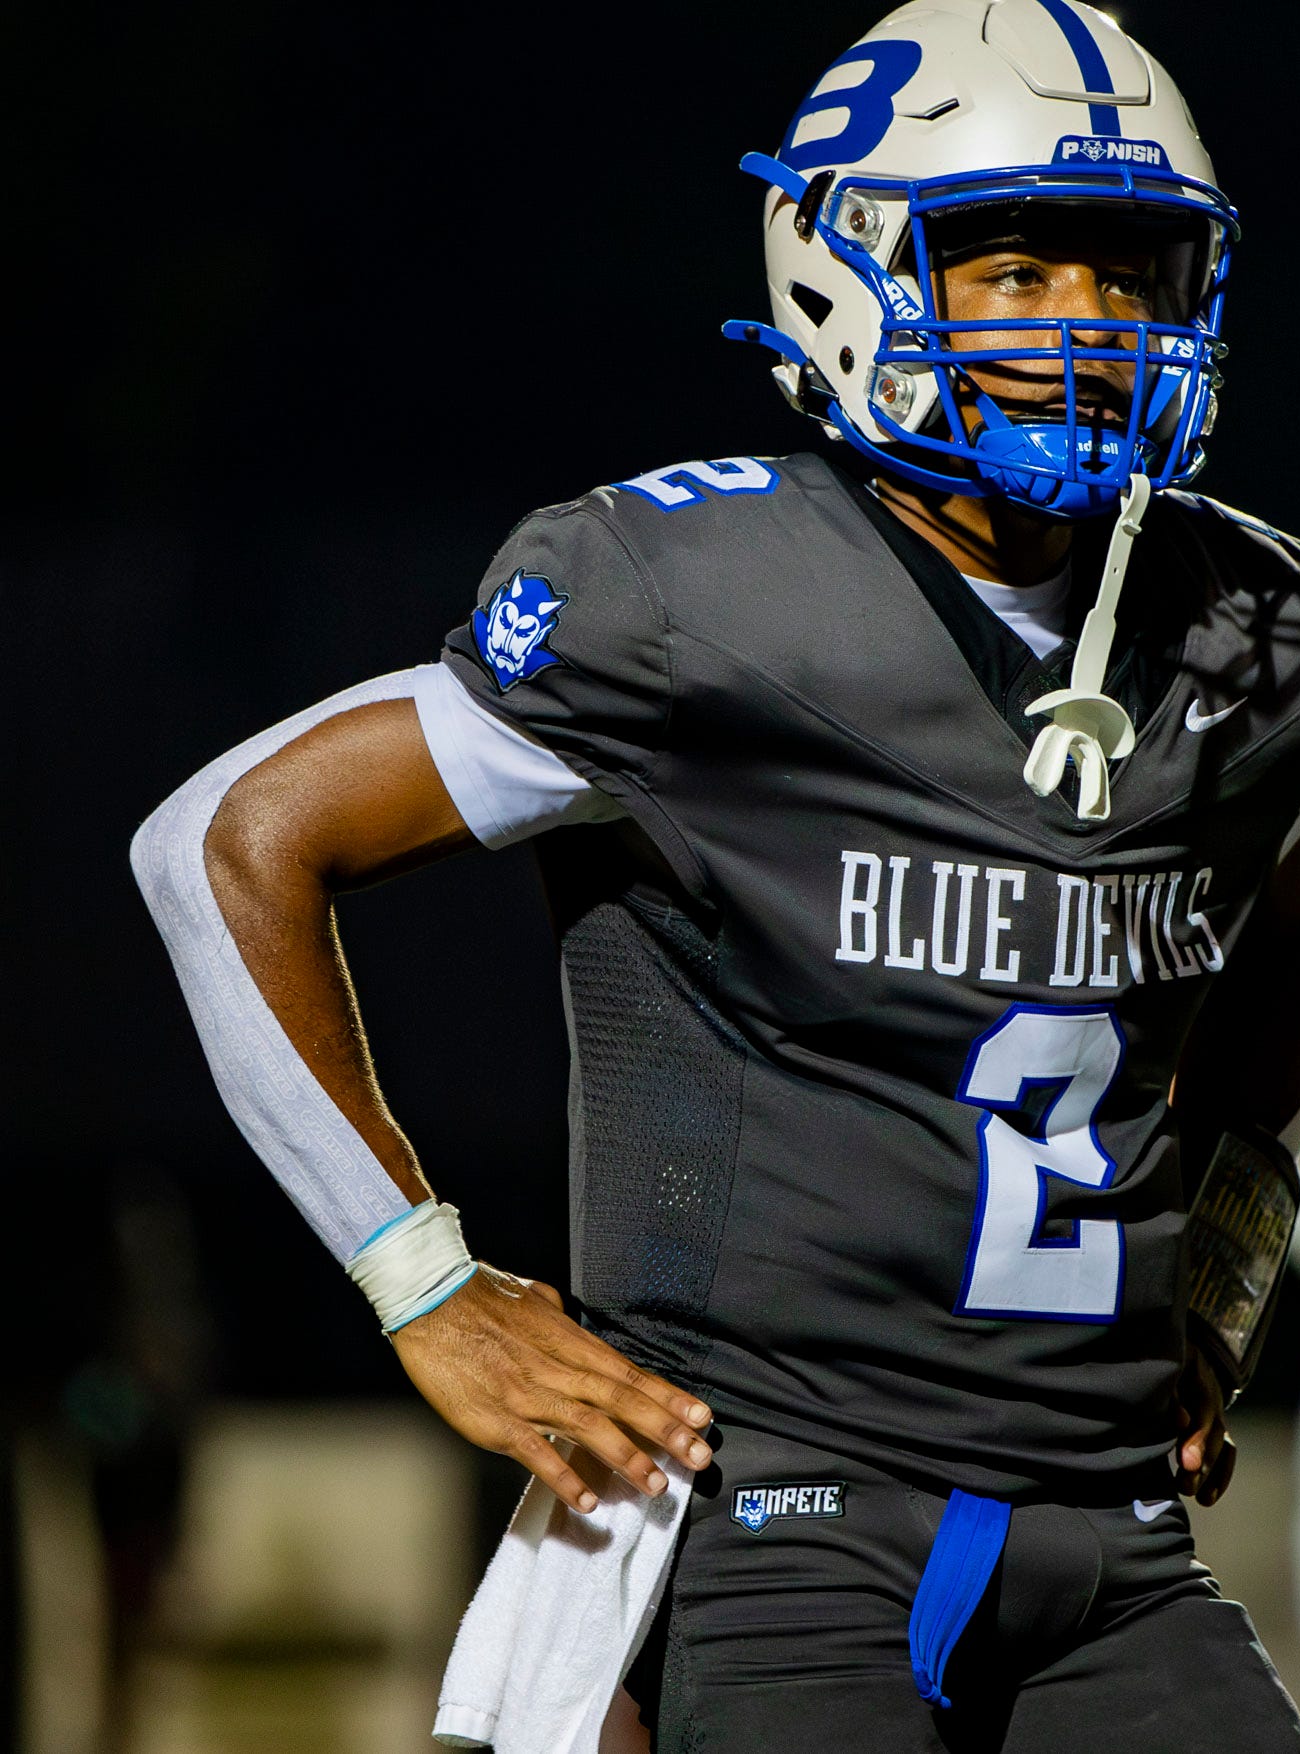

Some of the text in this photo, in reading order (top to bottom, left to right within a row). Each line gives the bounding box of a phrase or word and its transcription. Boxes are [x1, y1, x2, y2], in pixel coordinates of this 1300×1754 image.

[777, 39, 922, 172] B
[1061, 141, 1160, 165] PNISH
[1064, 439, 1119, 455] idell
[609, 456, 781, 513] 2
[835, 850, 1225, 987] BLUE DEVILS
[952, 1001, 1127, 1325] 2
[735, 1486, 840, 1517] COMPETE
